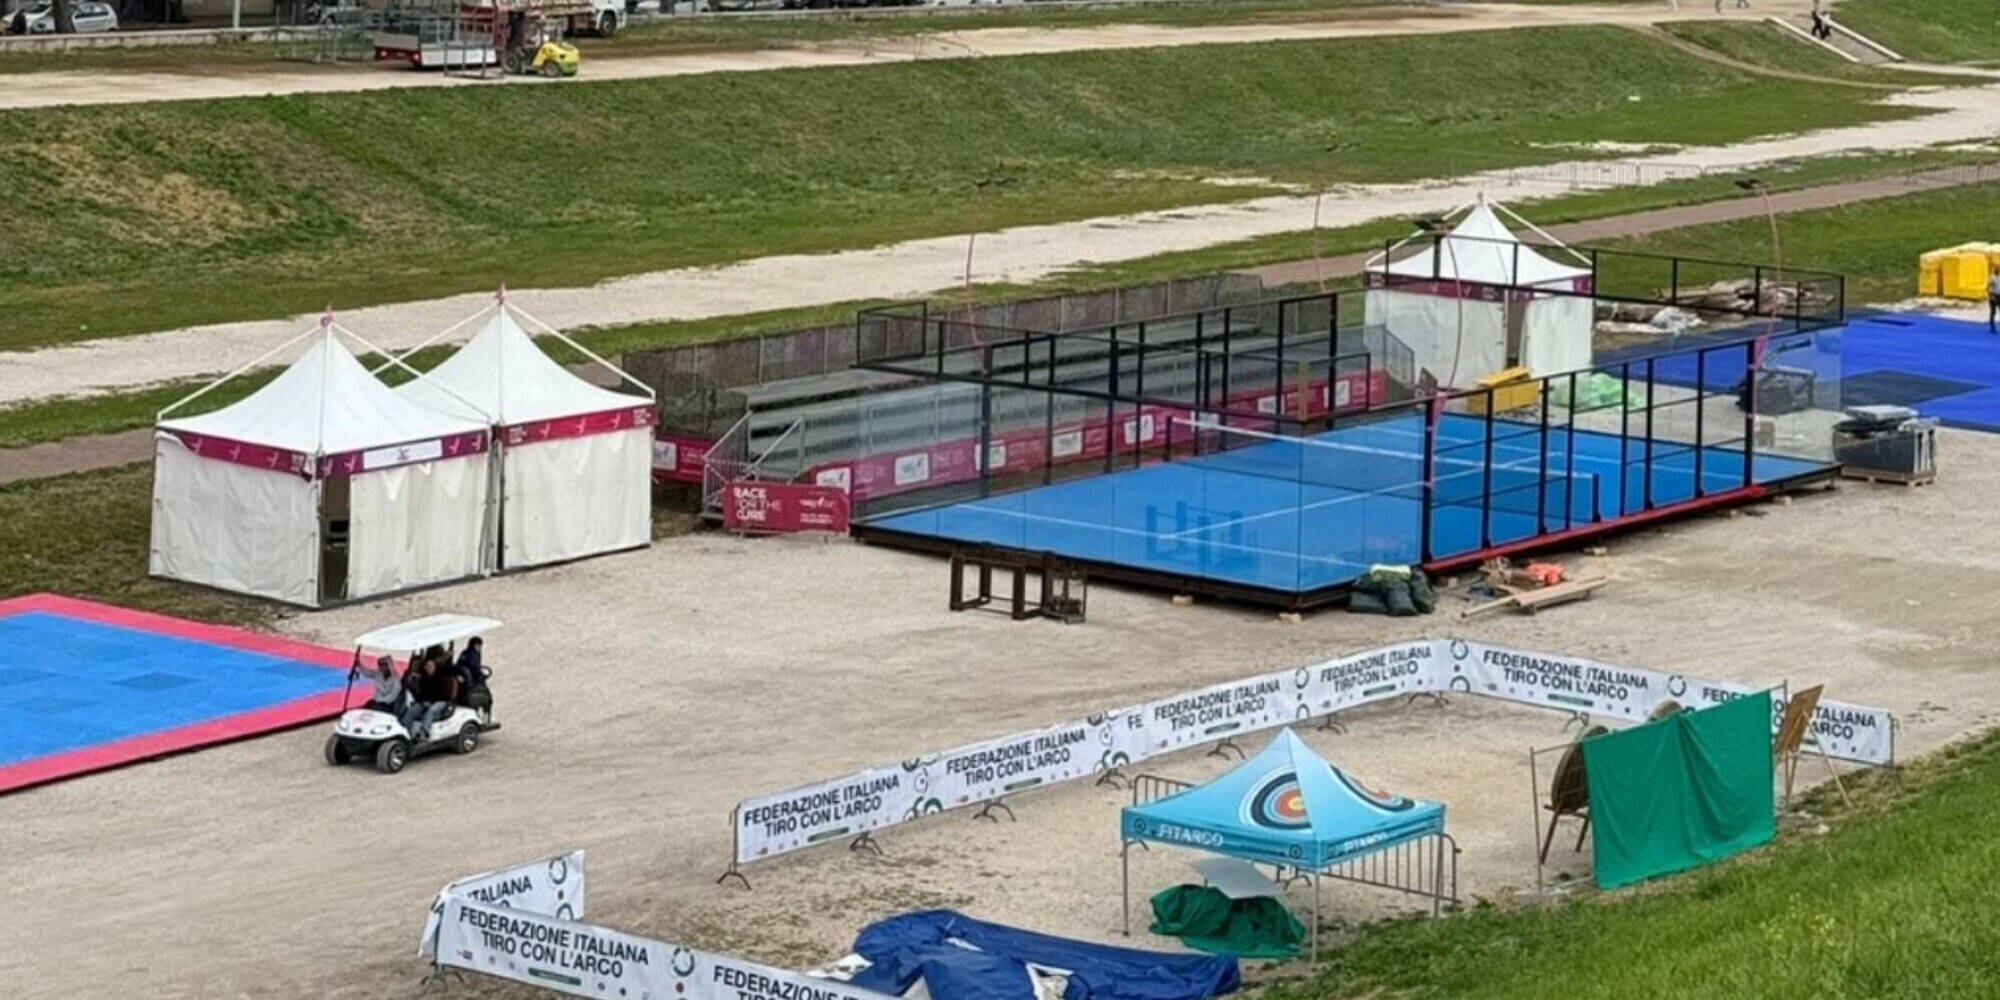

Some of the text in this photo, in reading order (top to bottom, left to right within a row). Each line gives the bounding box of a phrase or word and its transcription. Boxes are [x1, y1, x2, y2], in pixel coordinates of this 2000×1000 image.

[1357, 667, 1380, 686] CON
[1483, 650, 1649, 690] FEDERAZIONE ITALIANA
[1504, 668, 1628, 701] TIRO CON L'ARCO
[1154, 679, 1280, 722] FEDERAZIONE ITALIANA
[1170, 697, 1265, 731] TIRO CON L'ARCO
[1815, 705, 1876, 728] TALIANA
[946, 729, 1086, 775] FEDERAZIONE ITALIANA
[965, 747, 1070, 786] TIRO CON L'ARCO
[744, 774, 899, 827] FEDERAZIONE ITALIANA
[765, 795, 882, 838] TIRO CON L'ARCO
[1158, 823, 1224, 847] FITARCO
[459, 905, 649, 966] FEDERAZIONE ITALIANA
[481, 930, 623, 979] TIRO CON L'ARCO
